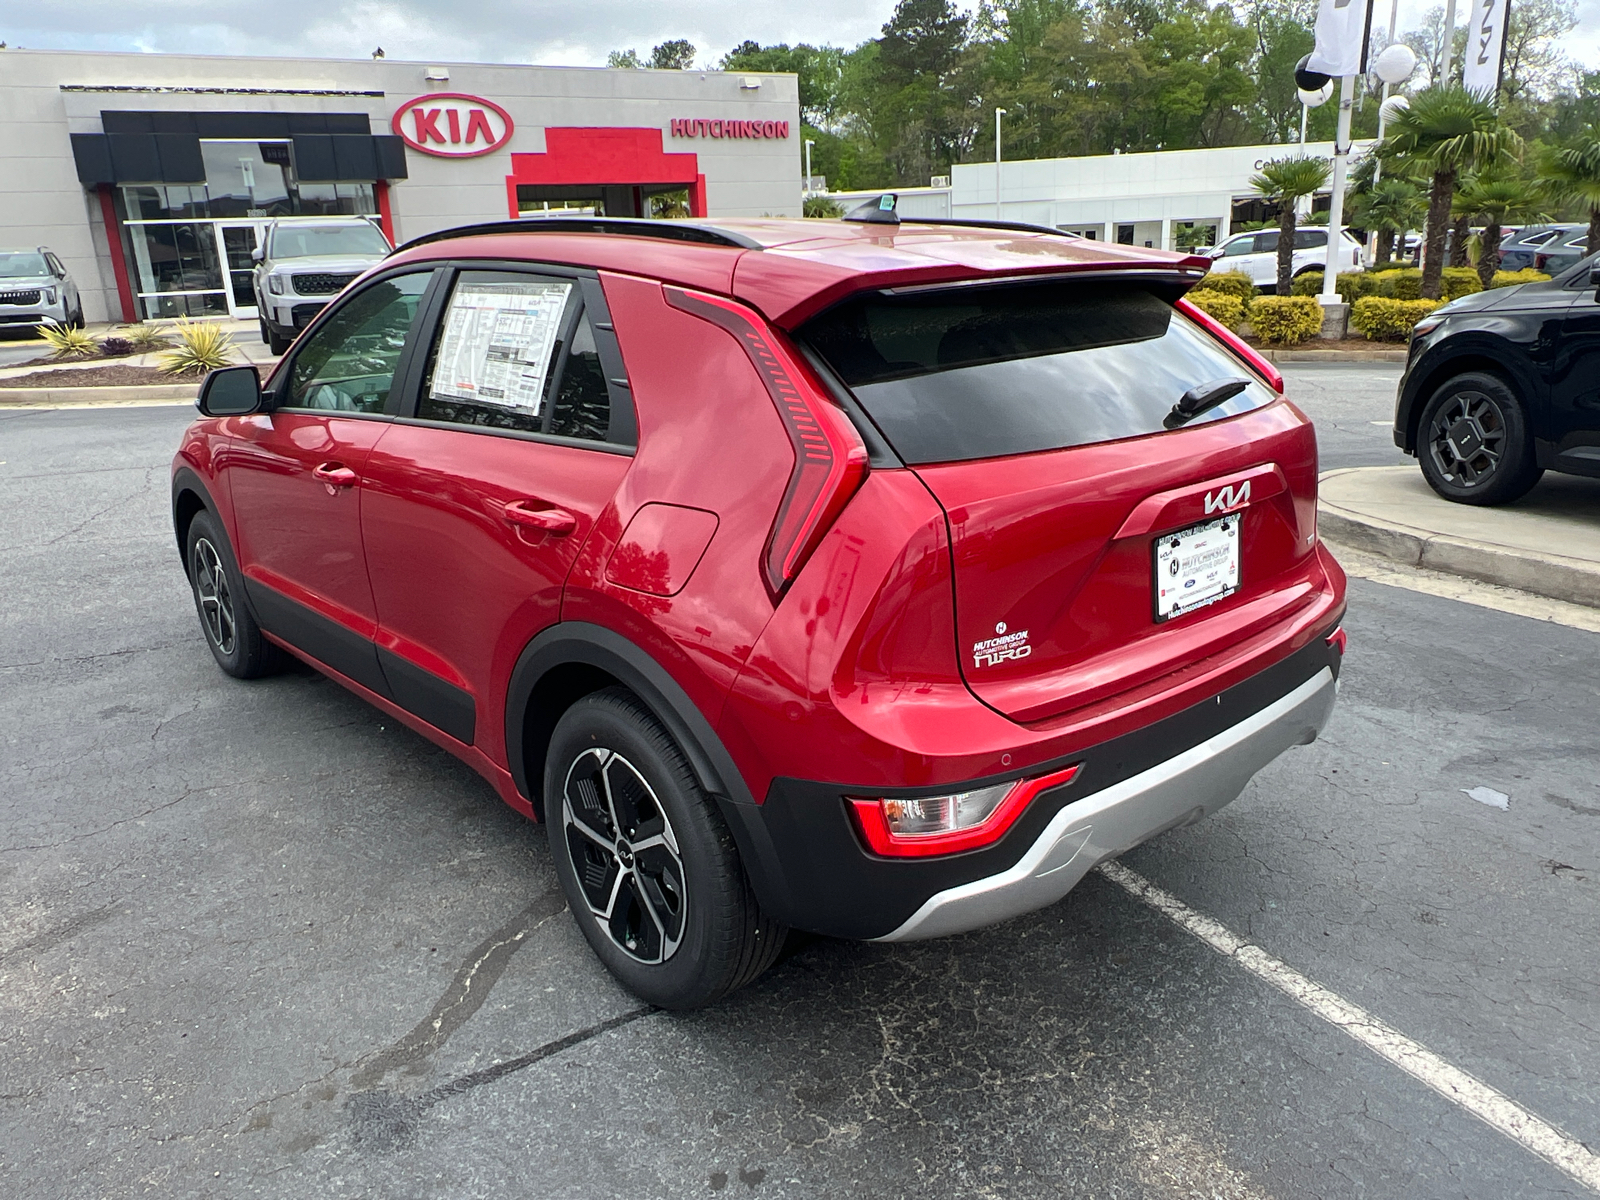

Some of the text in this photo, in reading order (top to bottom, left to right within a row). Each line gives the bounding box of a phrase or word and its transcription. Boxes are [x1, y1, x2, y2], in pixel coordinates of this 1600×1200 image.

[411, 108, 497, 144] KIA
[671, 118, 789, 140] HUTCHINSON
[1204, 480, 1251, 514] KIA
[1182, 545, 1230, 568] HUTCHINSON
[1182, 561, 1213, 578] AUTOMOTIVE
[1214, 556, 1228, 568] GROUP
[973, 630, 1028, 652] HUTCHINSON
[975, 639, 1026, 656] AUTOMOTIVE GROUP
